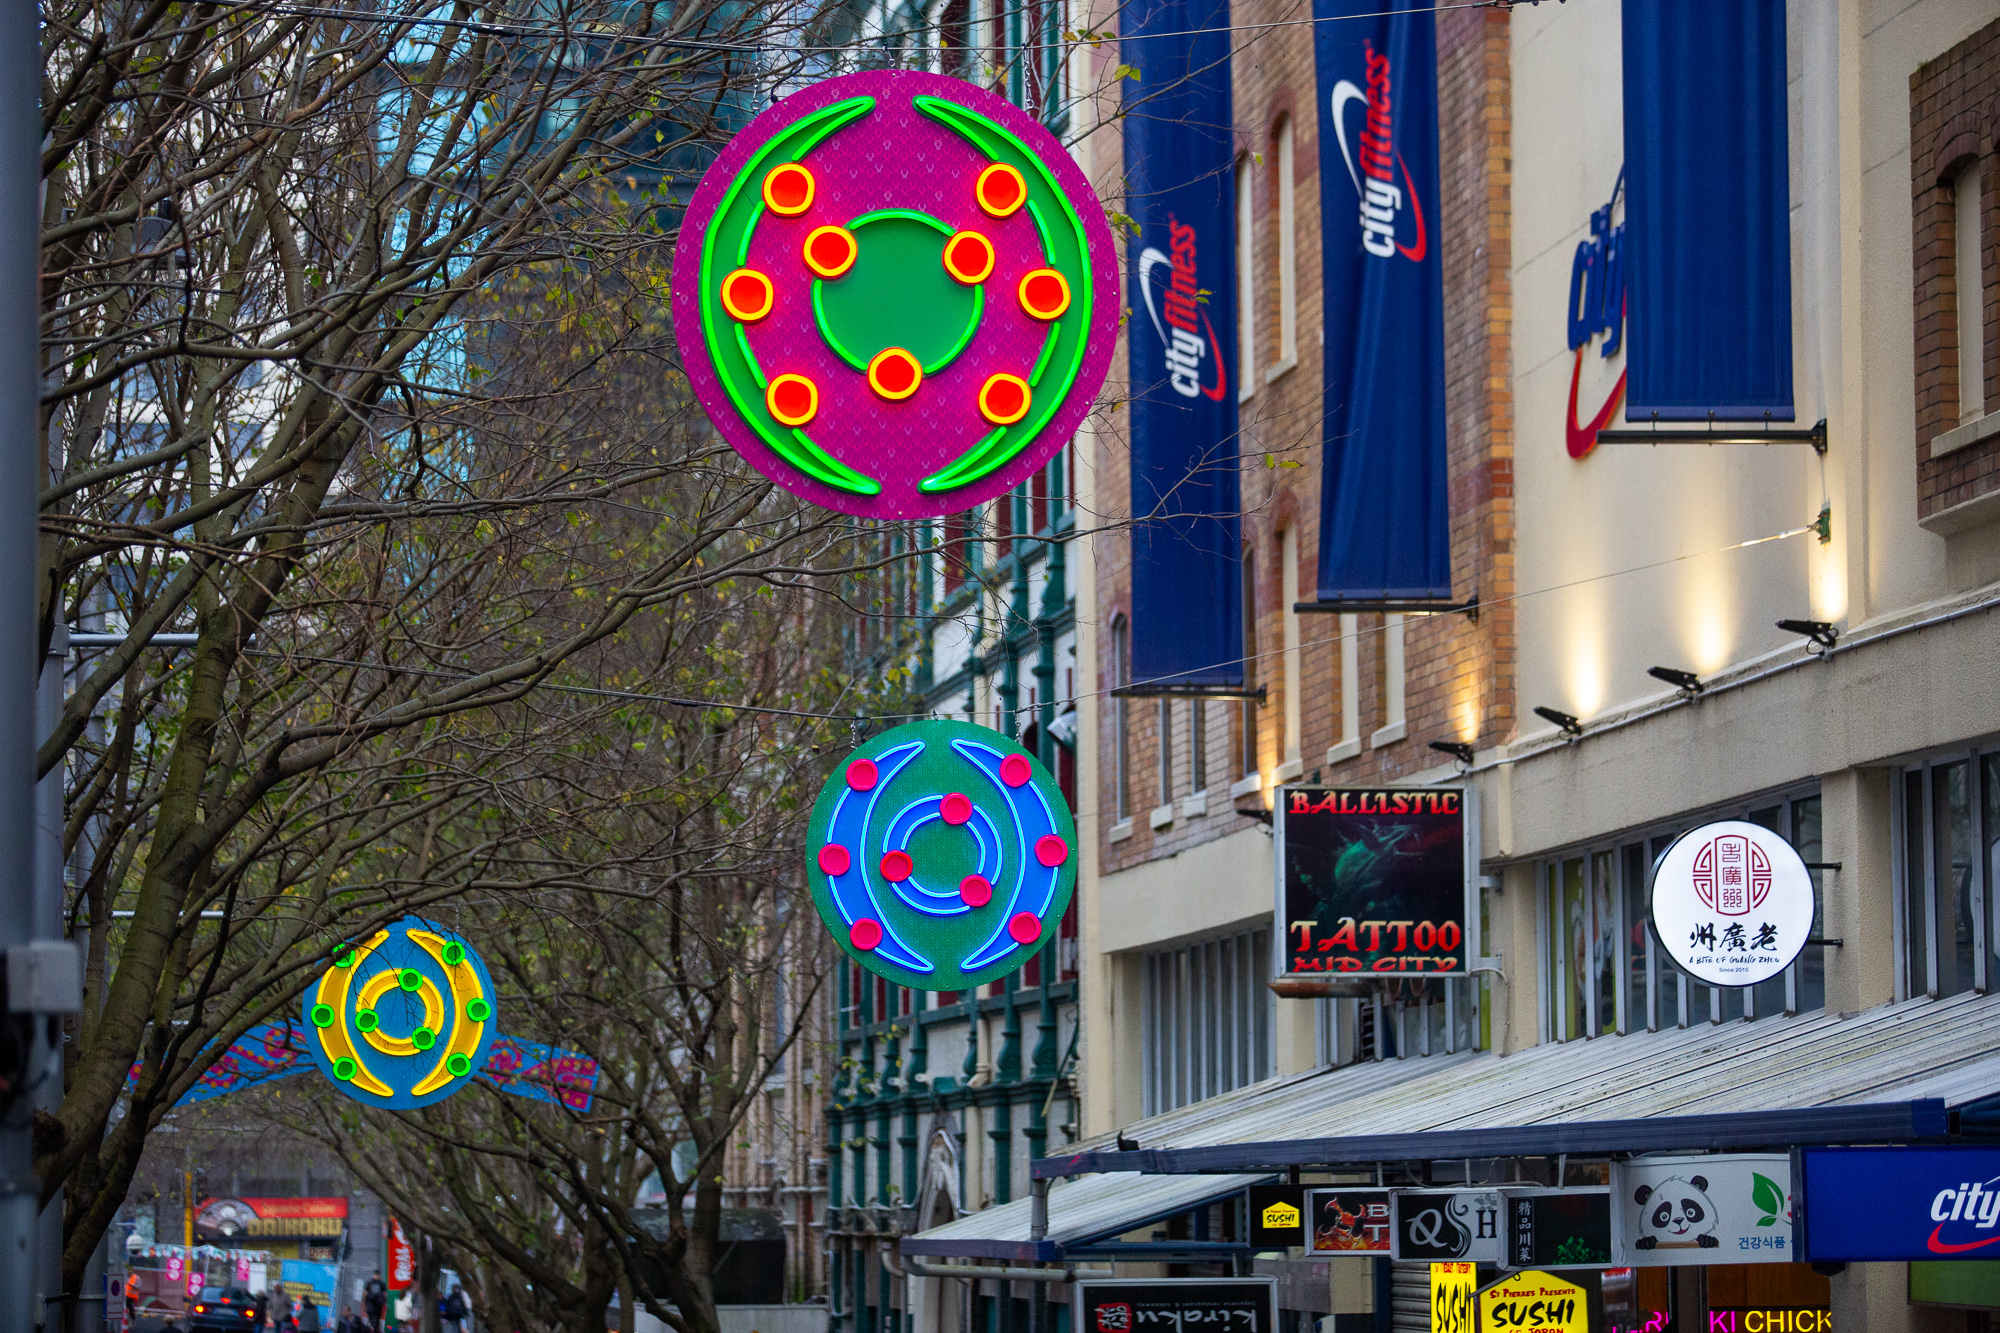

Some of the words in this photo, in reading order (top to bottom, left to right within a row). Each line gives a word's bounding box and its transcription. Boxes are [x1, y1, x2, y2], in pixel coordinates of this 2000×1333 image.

[1289, 790, 1459, 815] BALLISTIC
[1290, 916, 1461, 952] TATTOO
[1292, 956, 1363, 973] MID
[1371, 955, 1459, 973] CITY
[1696, 956, 1713, 965] BITE
[1729, 954, 1757, 965] GUANG
[1758, 956, 1780, 964] ZHOU
[1266, 1213, 1295, 1223] SUSHI
[1518, 1200, 1533, 1263] 精品川菜
[1738, 1235, 1786, 1250] 건강식품
[1436, 1281, 1471, 1333] SUSHI
[1492, 1298, 1575, 1328] SUSHI
[1136, 1308, 1258, 1333] kiraku
